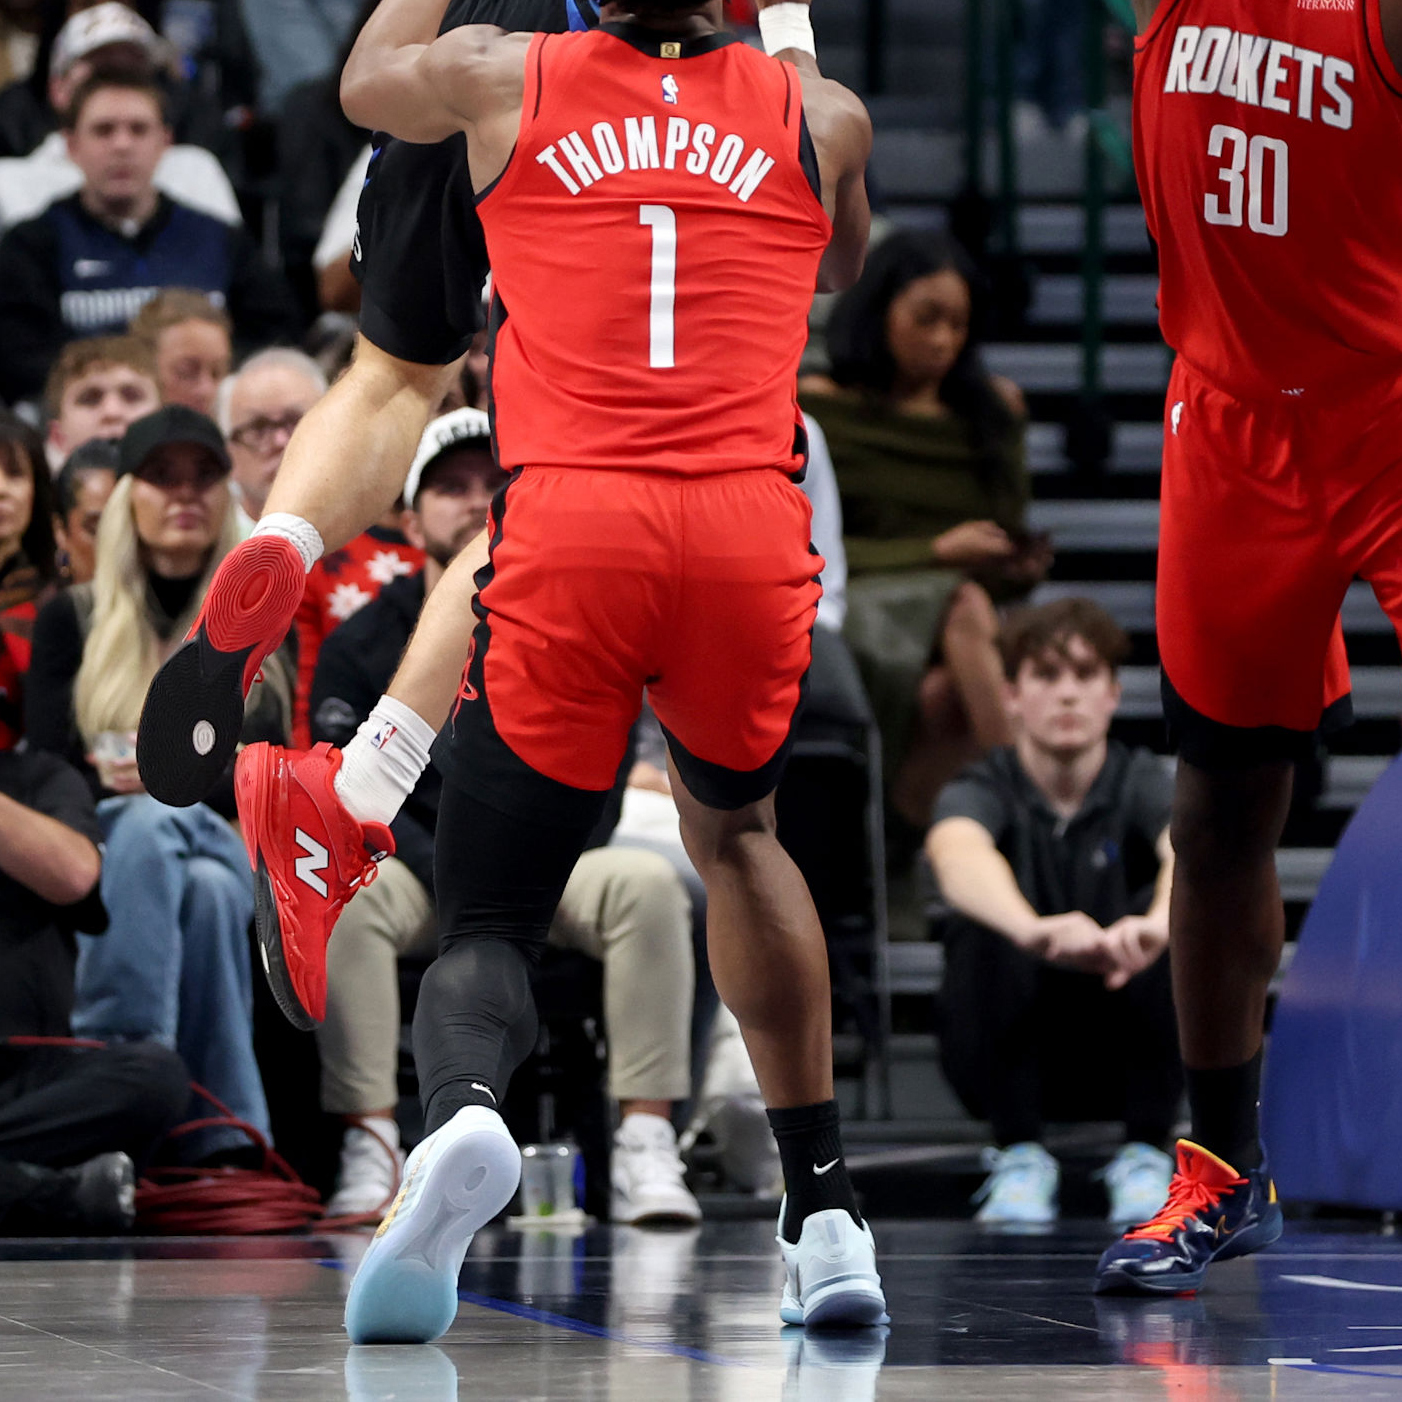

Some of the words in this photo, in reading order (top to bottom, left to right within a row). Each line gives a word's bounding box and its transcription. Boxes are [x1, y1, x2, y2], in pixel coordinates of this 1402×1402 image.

[1164, 25, 1354, 131] ROCKETS
[535, 115, 776, 203] THOMPSON
[1203, 123, 1289, 238] 30
[639, 204, 677, 369] 1
